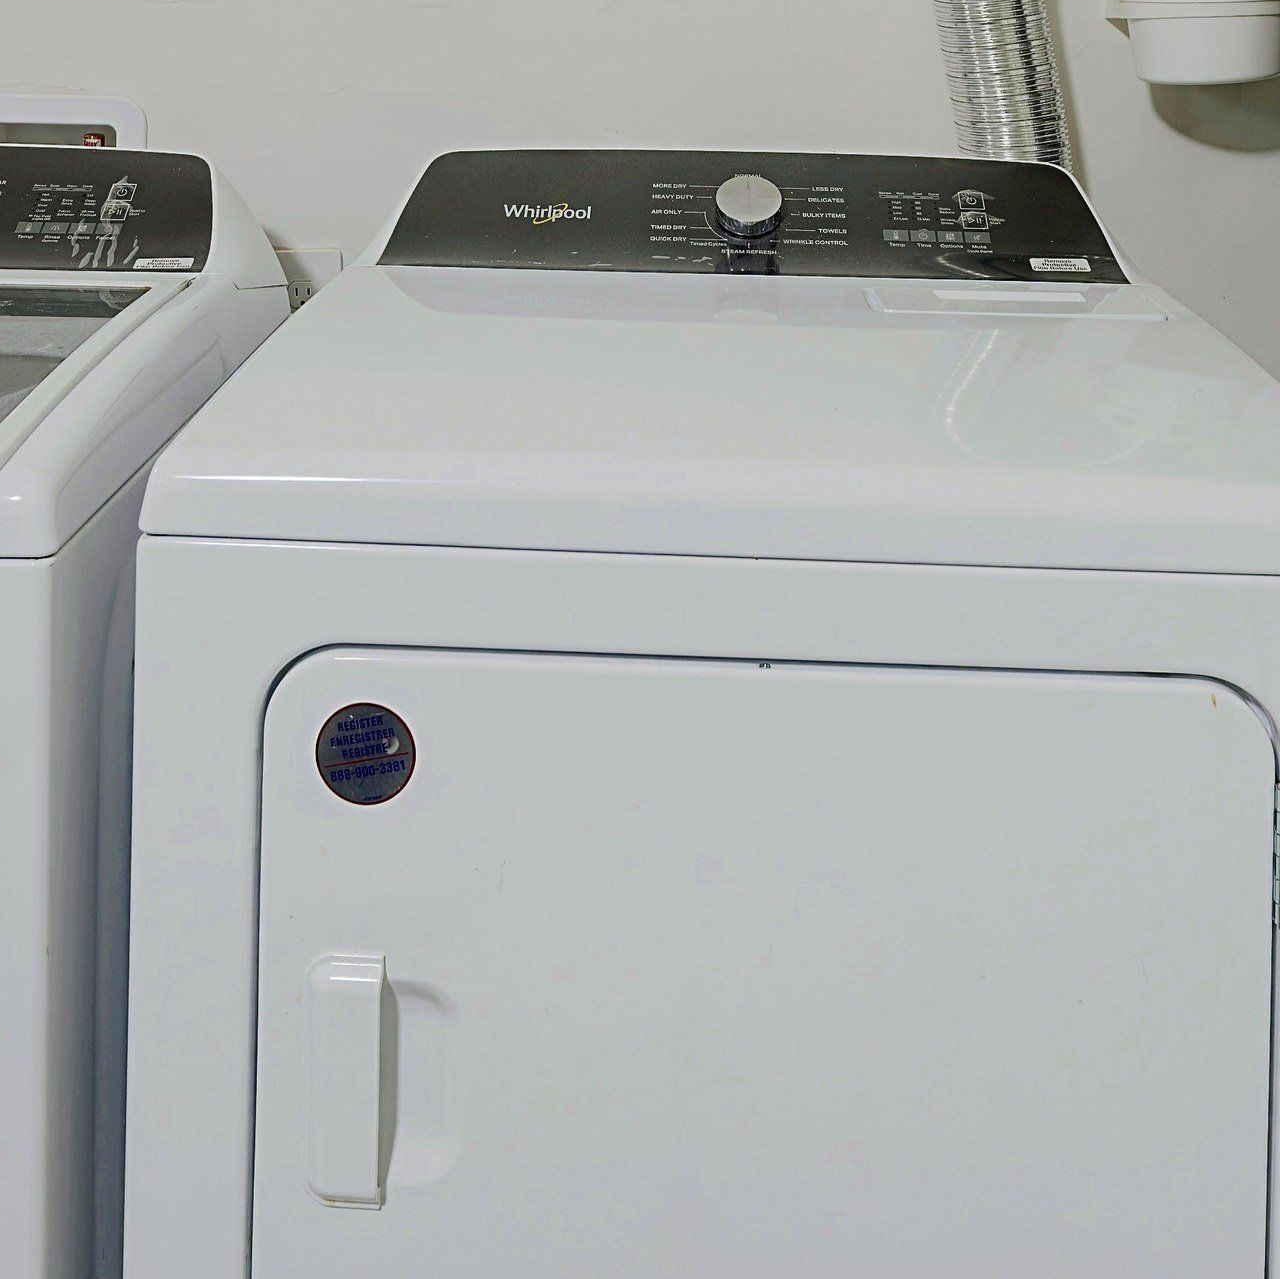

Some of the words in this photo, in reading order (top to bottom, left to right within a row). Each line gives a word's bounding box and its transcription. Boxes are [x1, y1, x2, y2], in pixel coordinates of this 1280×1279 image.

[503, 203, 592, 224] Whirlpool
[337, 715, 384, 732] REGISTER
[330, 728, 395, 747] ENREGISTRER
[342, 742, 388, 760] REGISTRE
[330, 760, 406, 782] 888-900-3381
